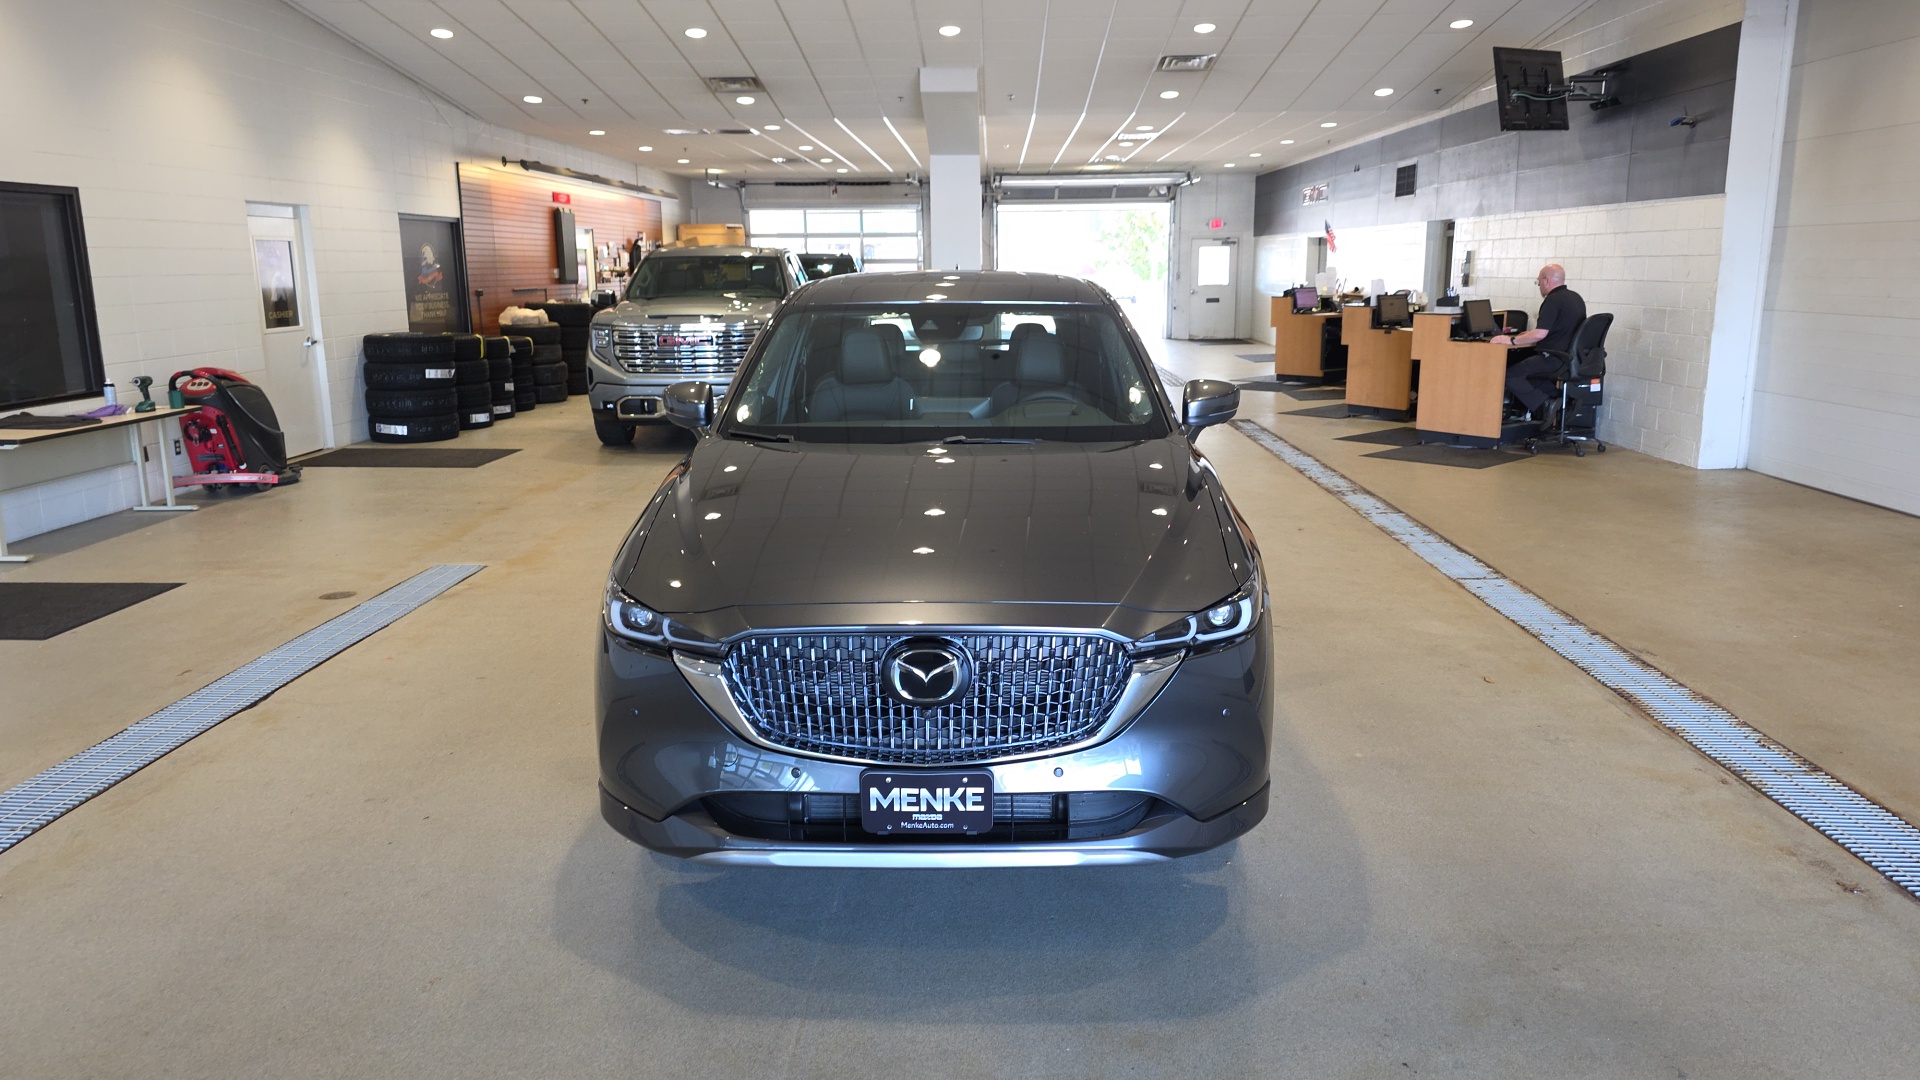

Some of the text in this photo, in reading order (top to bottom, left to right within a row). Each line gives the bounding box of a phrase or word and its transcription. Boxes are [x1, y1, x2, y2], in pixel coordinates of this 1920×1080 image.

[268, 310, 294, 320] CASHIER
[658, 335, 712, 346] GMC
[869, 787, 985, 812] MENKE
[912, 813, 943, 821] mazda
[900, 821, 954, 829] MenkeAuto.com
